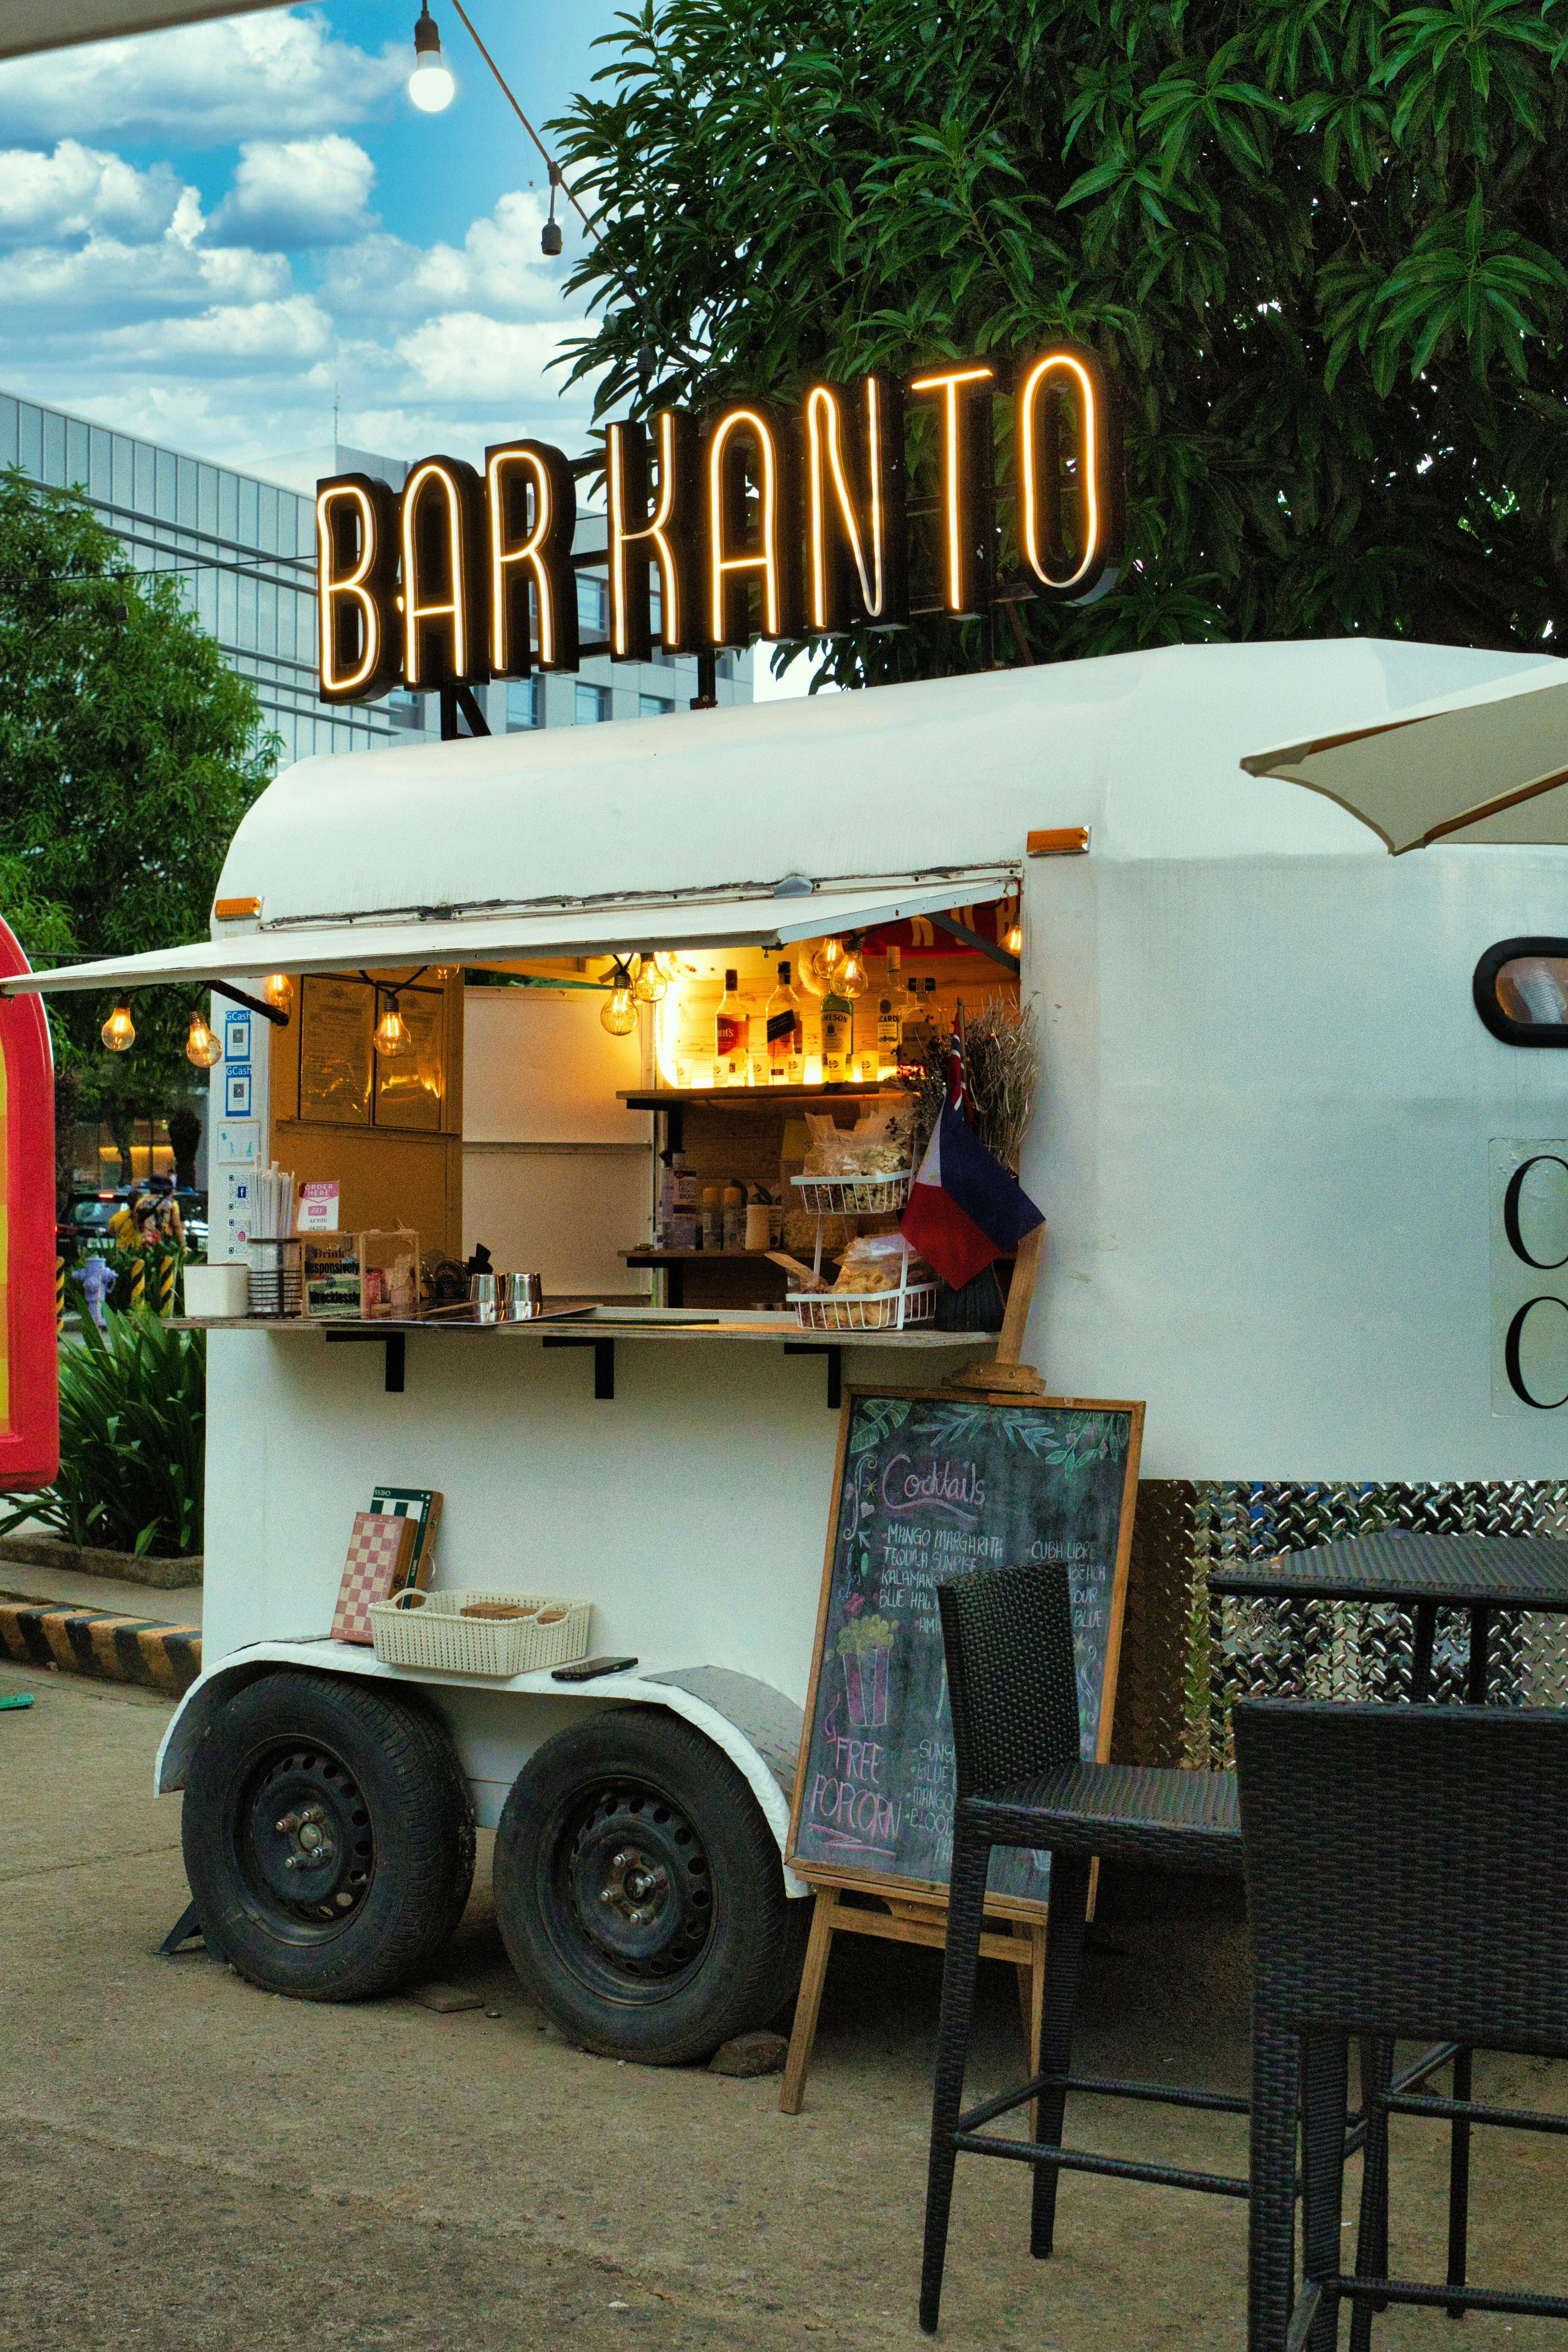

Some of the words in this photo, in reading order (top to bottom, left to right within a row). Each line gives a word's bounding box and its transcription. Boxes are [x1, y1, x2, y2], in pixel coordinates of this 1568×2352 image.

[226, 1011, 251, 1021] GCash
[226, 1066, 251, 1076] GCash
[305, 1260, 359, 1275] Responsively
[887, 1523, 931, 1546] MANGO
[879, 1589, 906, 1608] BLUE
[1074, 1609, 1102, 1628] BLUE
[835, 1736, 885, 1785] FREE
[917, 1762, 949, 1786] BLUE
[810, 1773, 902, 1840] POPCORN
[913, 1786, 954, 1813] MANGO
